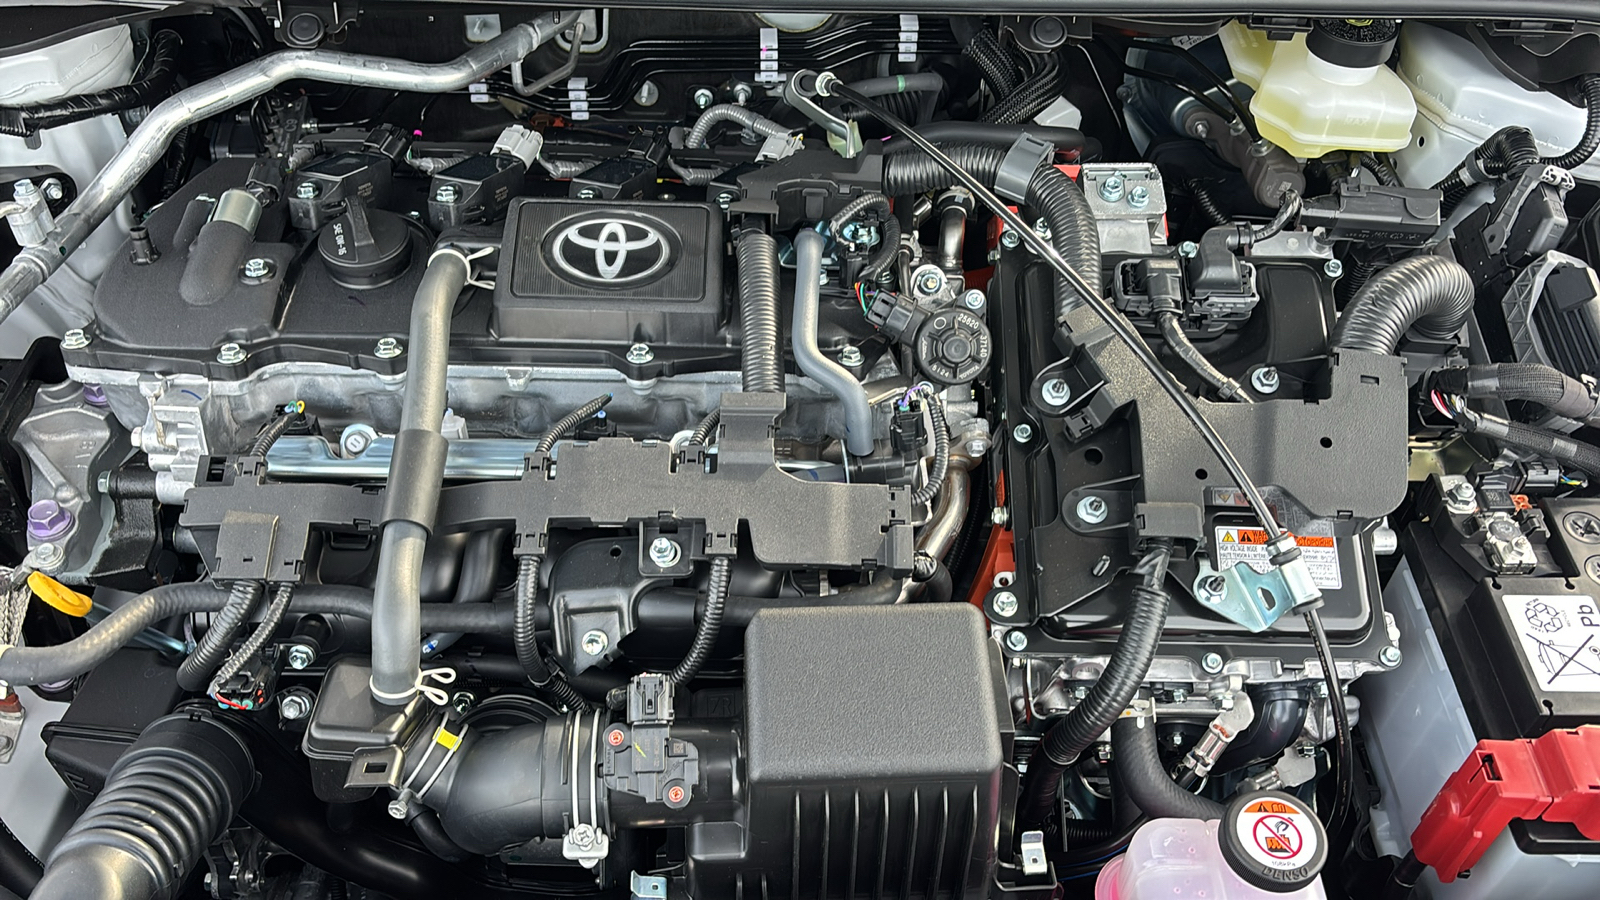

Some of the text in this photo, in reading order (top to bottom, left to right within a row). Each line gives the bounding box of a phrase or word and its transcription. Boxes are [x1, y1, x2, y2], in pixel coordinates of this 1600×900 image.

[333, 222, 347, 255] SAE 0W-16
[957, 313, 979, 329] 25620
[959, 365, 980, 379] TOYOTA
[1577, 604, 1600, 627] Pb
[1262, 866, 1309, 881] DENSO
